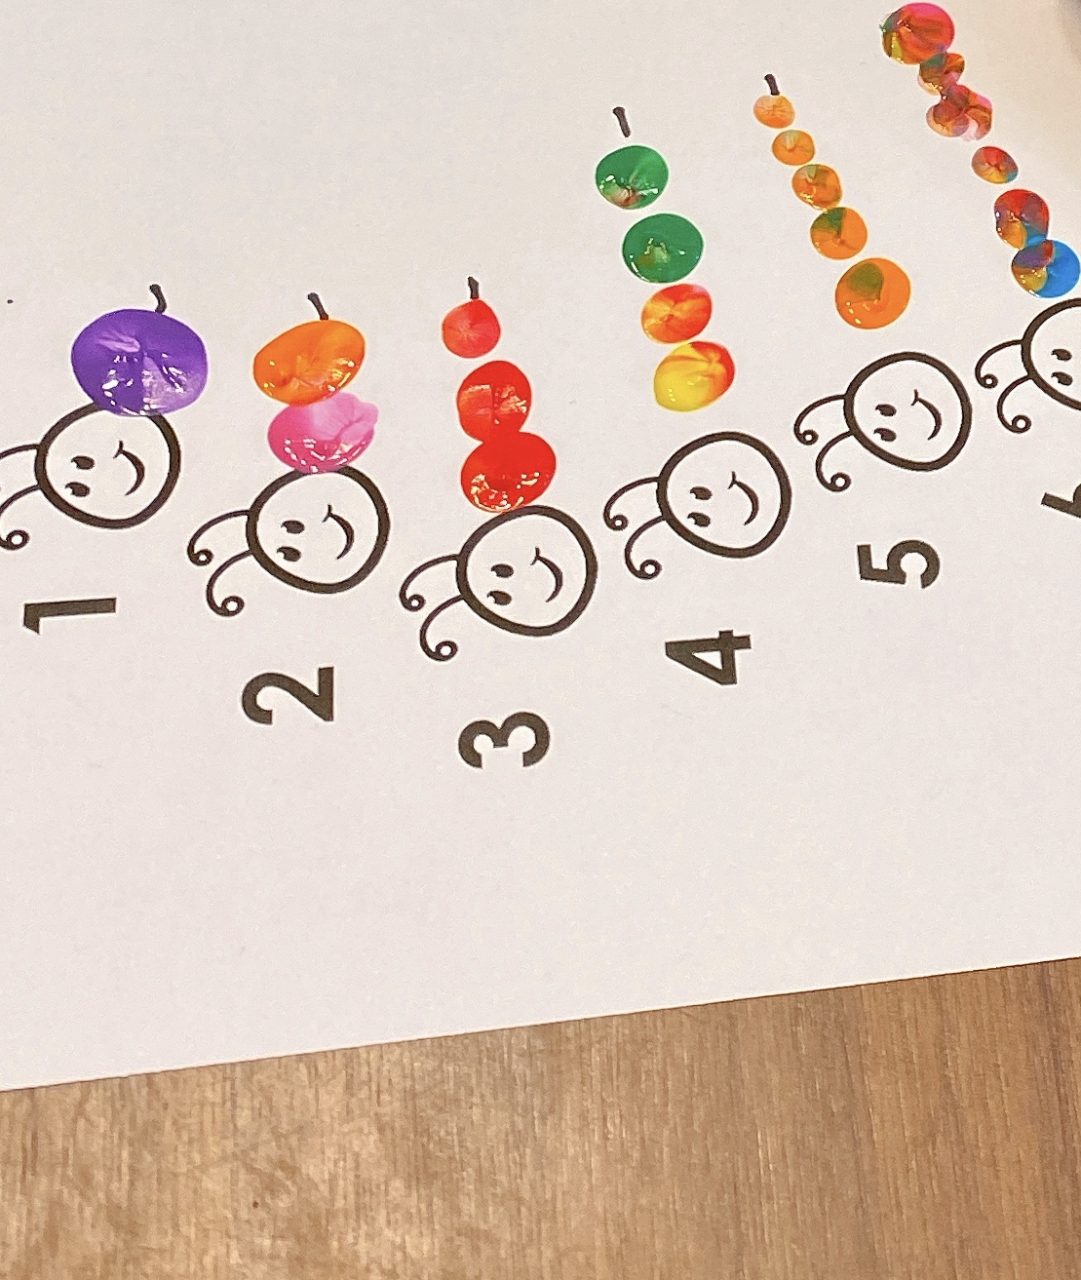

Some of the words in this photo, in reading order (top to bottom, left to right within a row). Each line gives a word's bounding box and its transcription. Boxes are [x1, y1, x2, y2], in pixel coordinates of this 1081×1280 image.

[857, 540, 940, 588] 5
[24, 598, 116, 634] 1
[665, 630, 751, 685] 4
[242, 667, 333, 724] 2
[458, 712, 550, 768] 3
